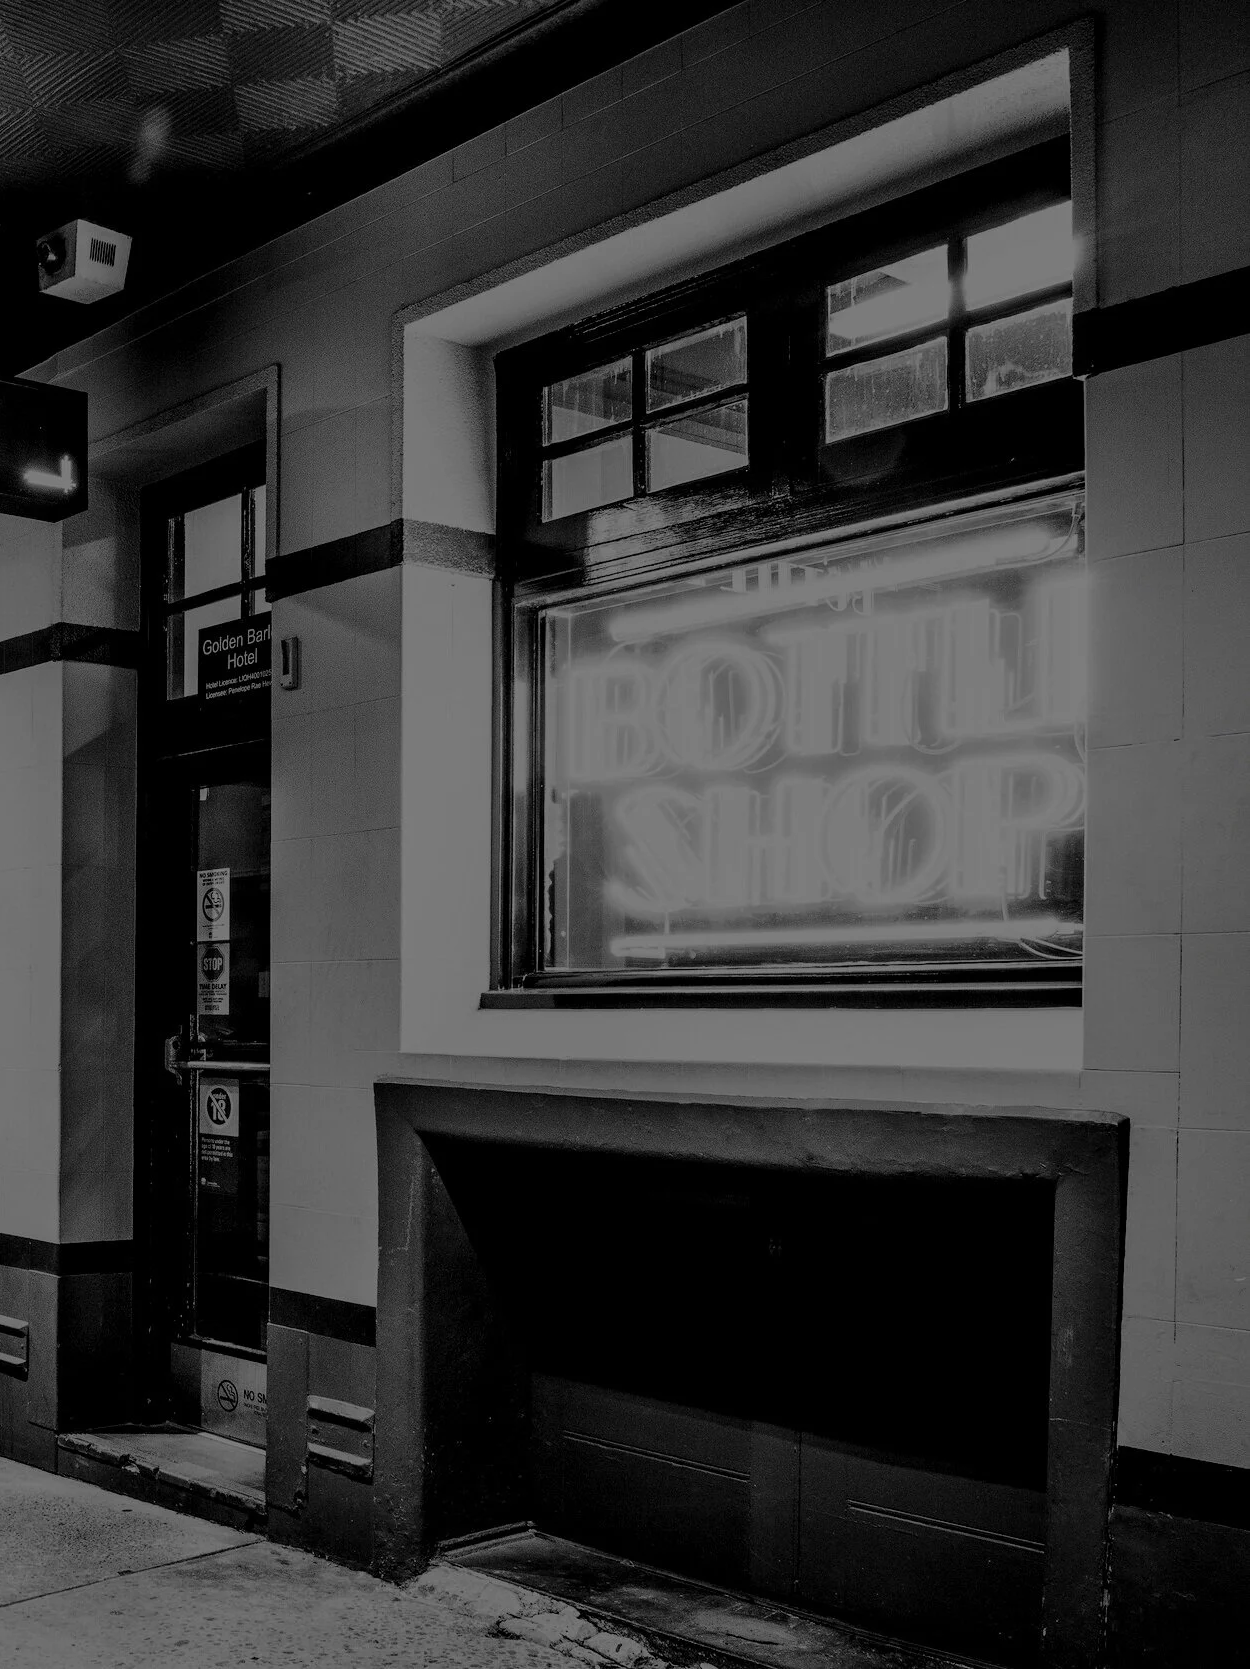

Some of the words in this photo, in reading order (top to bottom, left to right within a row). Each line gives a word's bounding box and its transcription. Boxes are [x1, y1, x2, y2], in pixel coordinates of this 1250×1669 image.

[202, 634, 243, 655] Golden
[227, 647, 258, 670] Hotel
[604, 753, 1086, 920] SHOP
[203, 957, 223, 971] STOP
[210, 1099, 227, 1122] 18
[243, 1389, 255, 1401] NO
